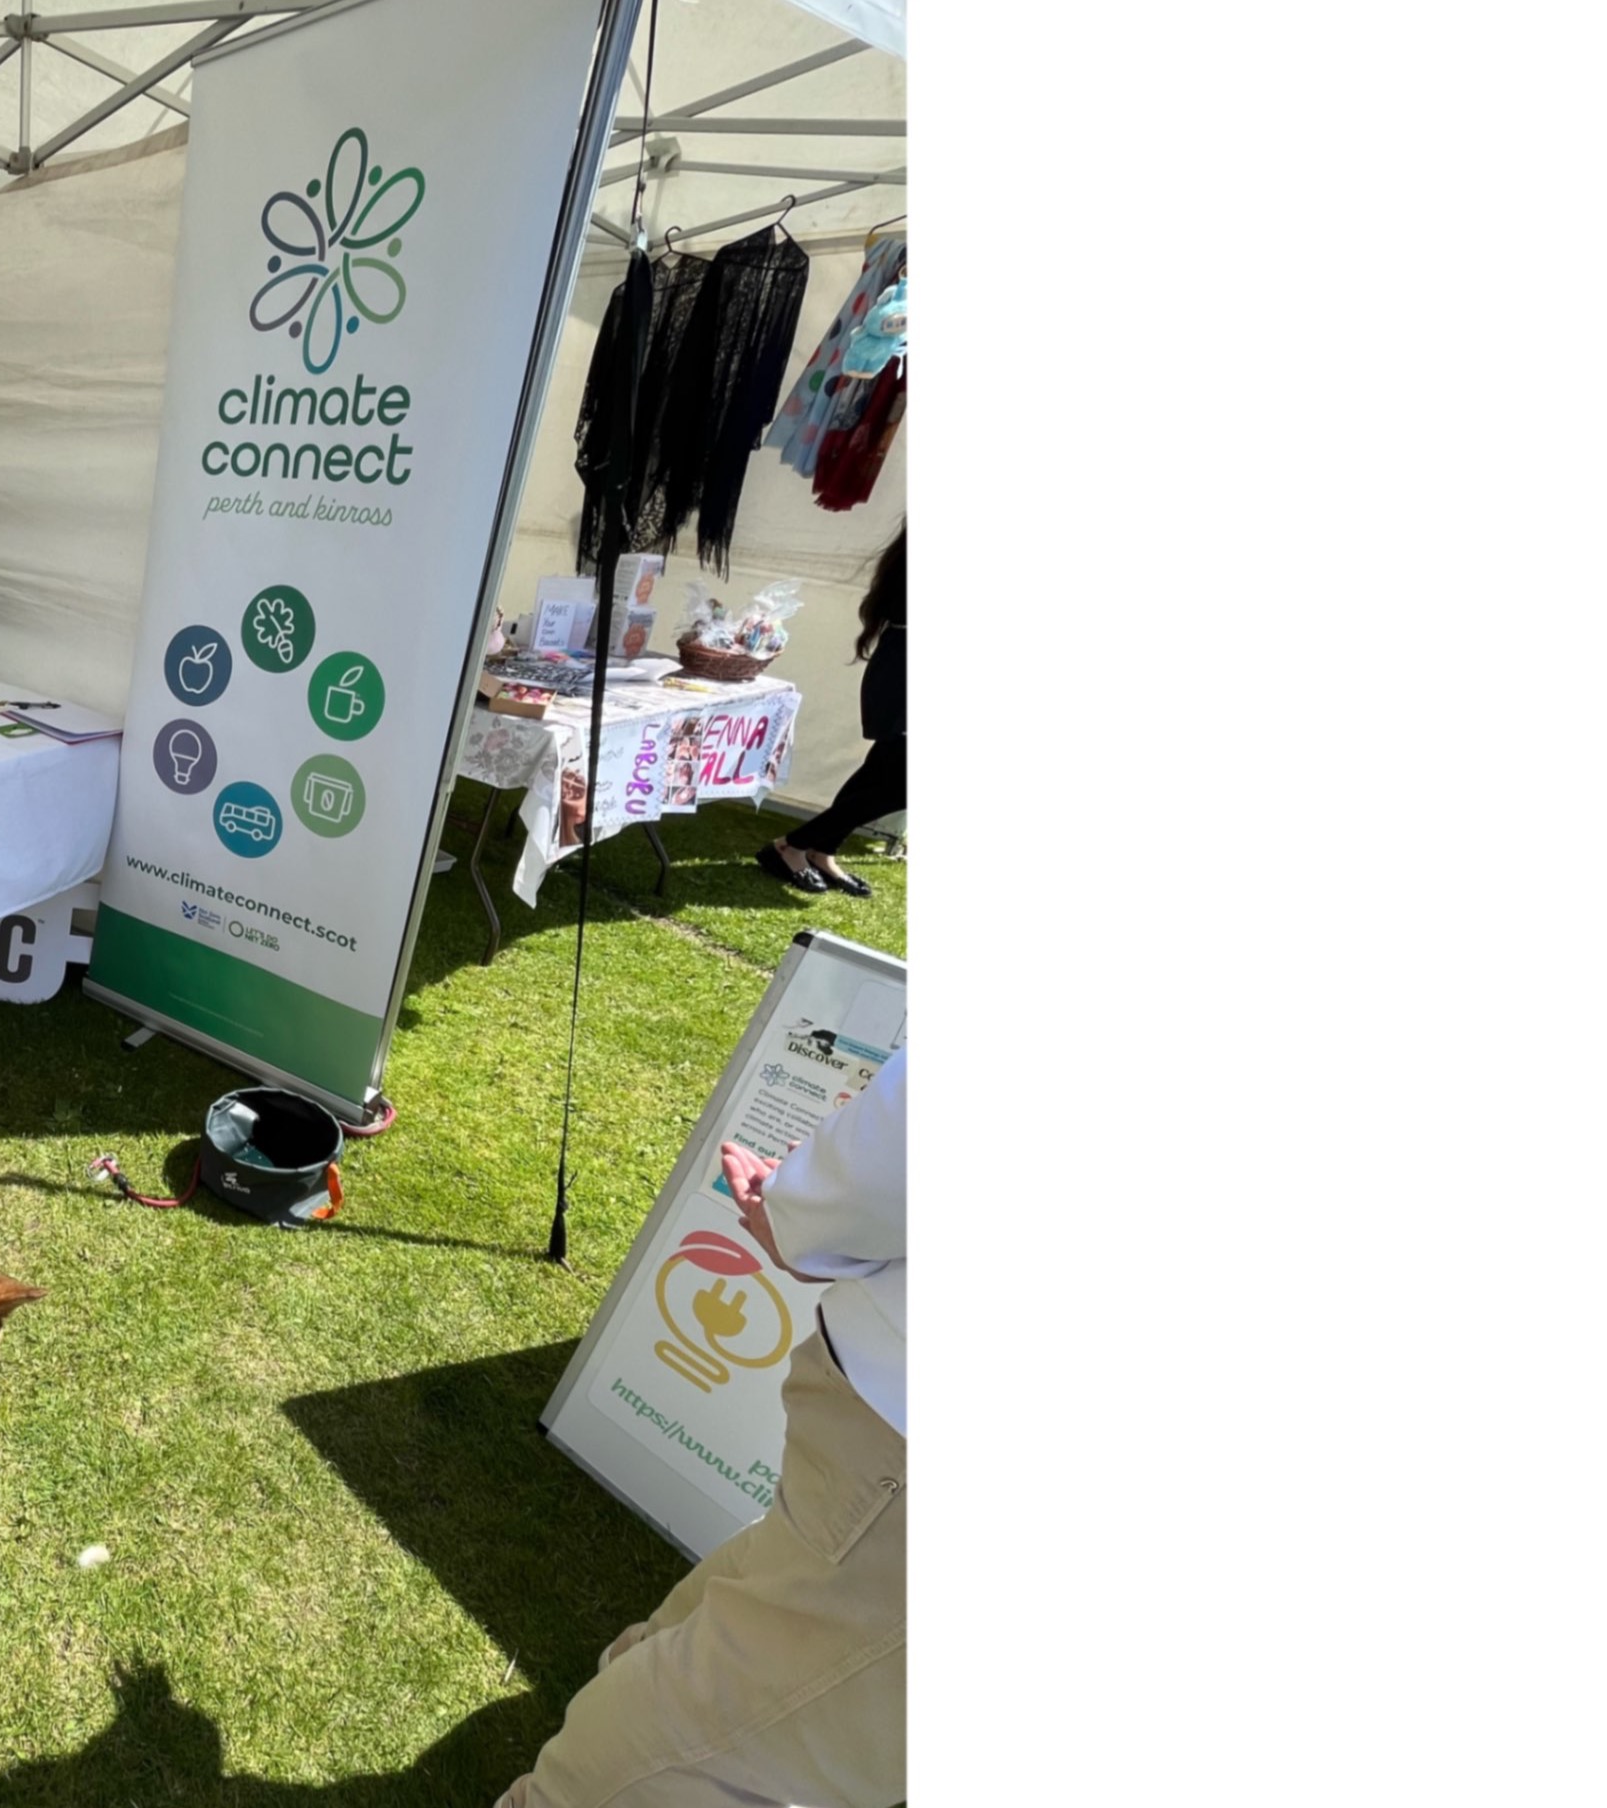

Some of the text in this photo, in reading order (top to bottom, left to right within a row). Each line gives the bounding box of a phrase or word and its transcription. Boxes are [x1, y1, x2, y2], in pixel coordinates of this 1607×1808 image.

[218, 373, 411, 426] climate
[202, 433, 414, 485] connect
[202, 491, 393, 527] perth and kinross
[625, 723, 661, 815] LABUBU
[699, 750, 754, 786] ALL
[125, 854, 358, 952] www.climateconnect.scot
[787, 1041, 849, 1070] Discover
[733, 1132, 757, 1149] Find
